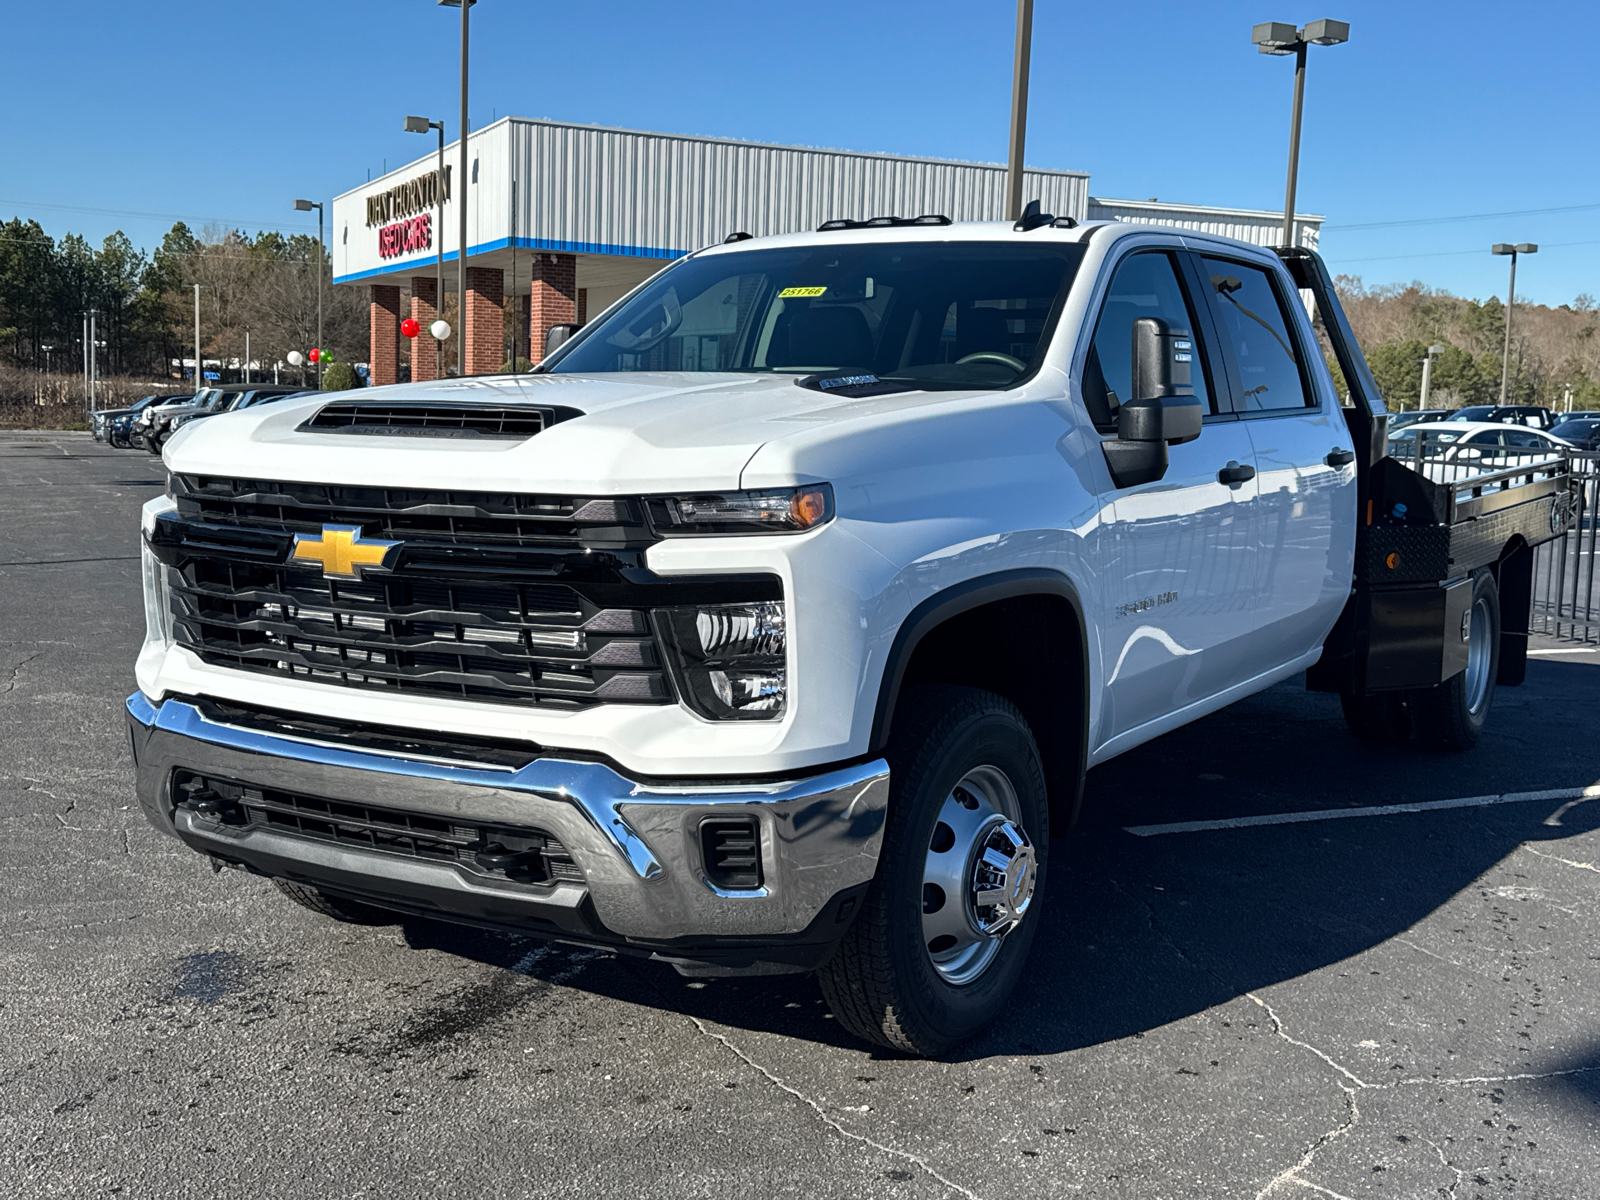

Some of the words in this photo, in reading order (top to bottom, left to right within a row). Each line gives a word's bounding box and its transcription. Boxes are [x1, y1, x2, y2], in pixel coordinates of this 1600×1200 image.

[366, 191, 391, 228] JOHN
[390, 165, 452, 220] THORNTON
[379, 223, 402, 259] USED
[402, 213, 432, 253] CARS
[781, 288, 822, 296] 251766
